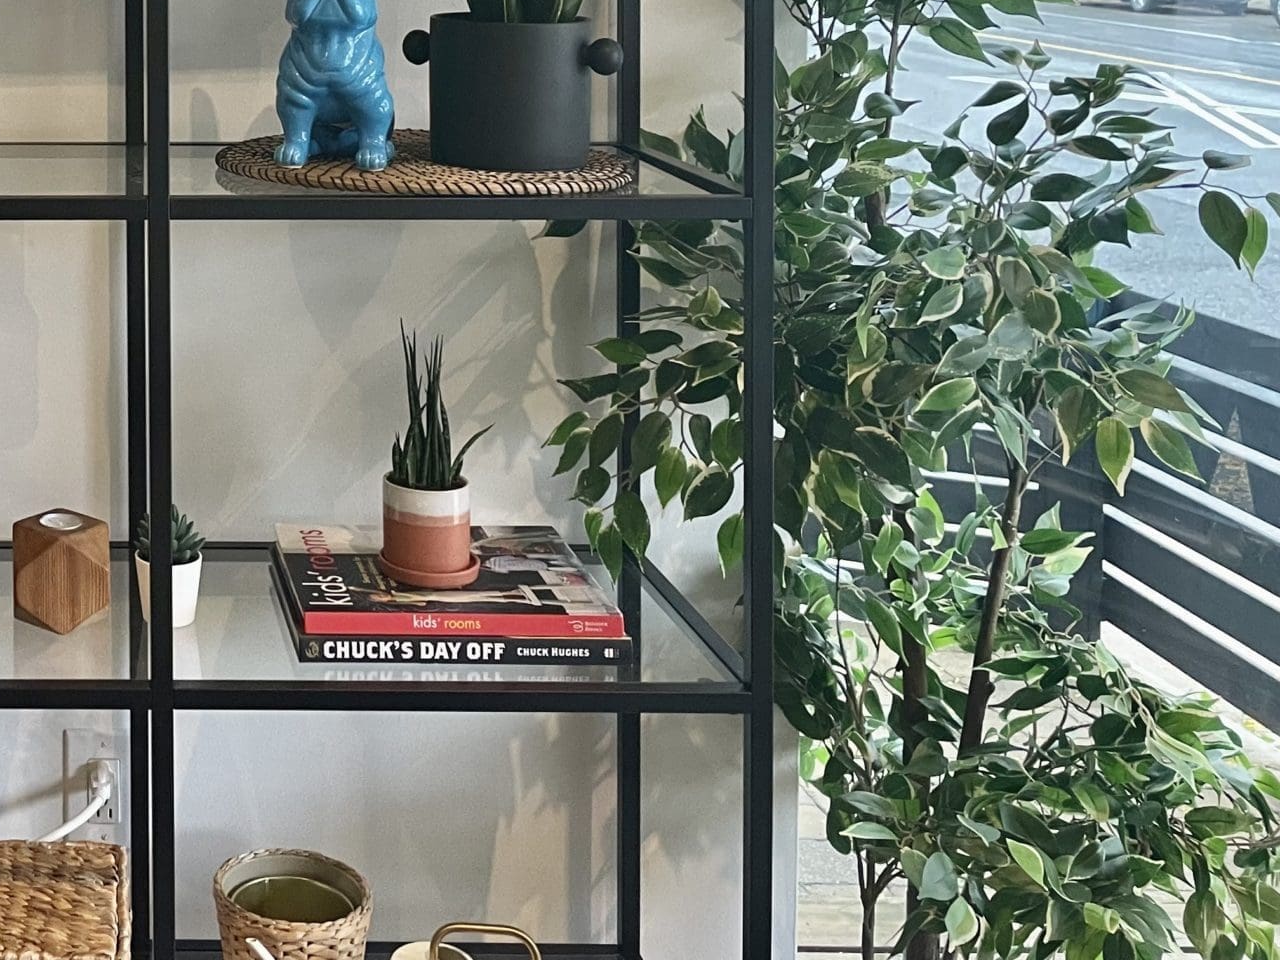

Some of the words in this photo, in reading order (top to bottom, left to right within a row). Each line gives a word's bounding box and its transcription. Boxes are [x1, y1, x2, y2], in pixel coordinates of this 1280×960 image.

[300, 529, 334, 569] rooms
[444, 619, 481, 630] rooms
[420, 642, 463, 660] DAY
[466, 642, 506, 660] OFF
[516, 647, 549, 657] CHUCK
[551, 647, 590, 657] HUGHES
